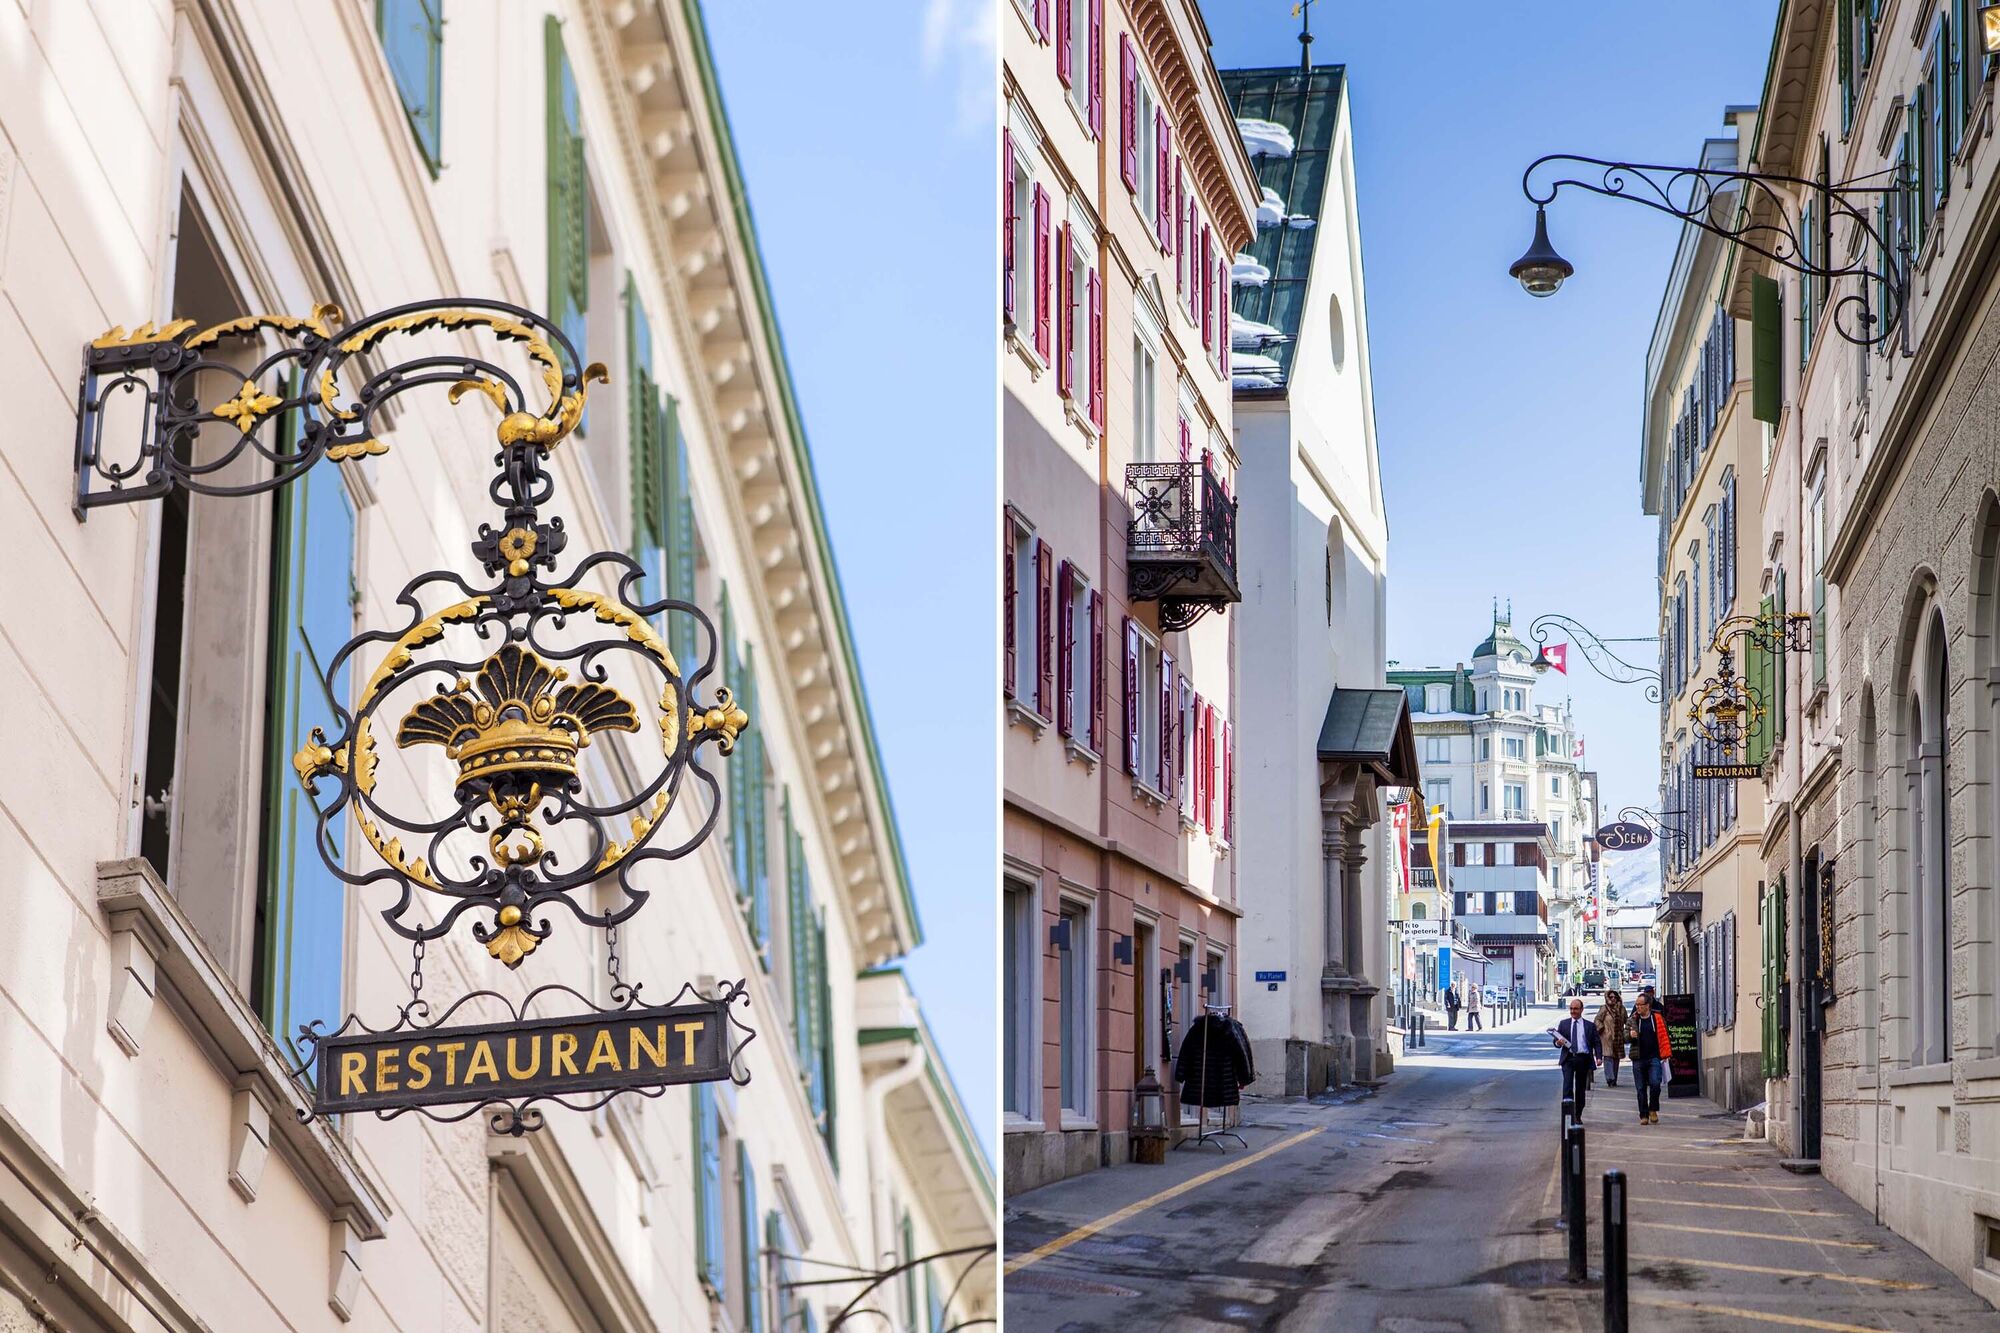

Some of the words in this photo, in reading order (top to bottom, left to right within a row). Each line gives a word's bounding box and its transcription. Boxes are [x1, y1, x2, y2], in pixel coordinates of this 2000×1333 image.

[1696, 767, 1758, 777] RESTAURANT
[1606, 825, 1649, 849] SCENA
[339, 1021, 704, 1096] RESTAURANT
